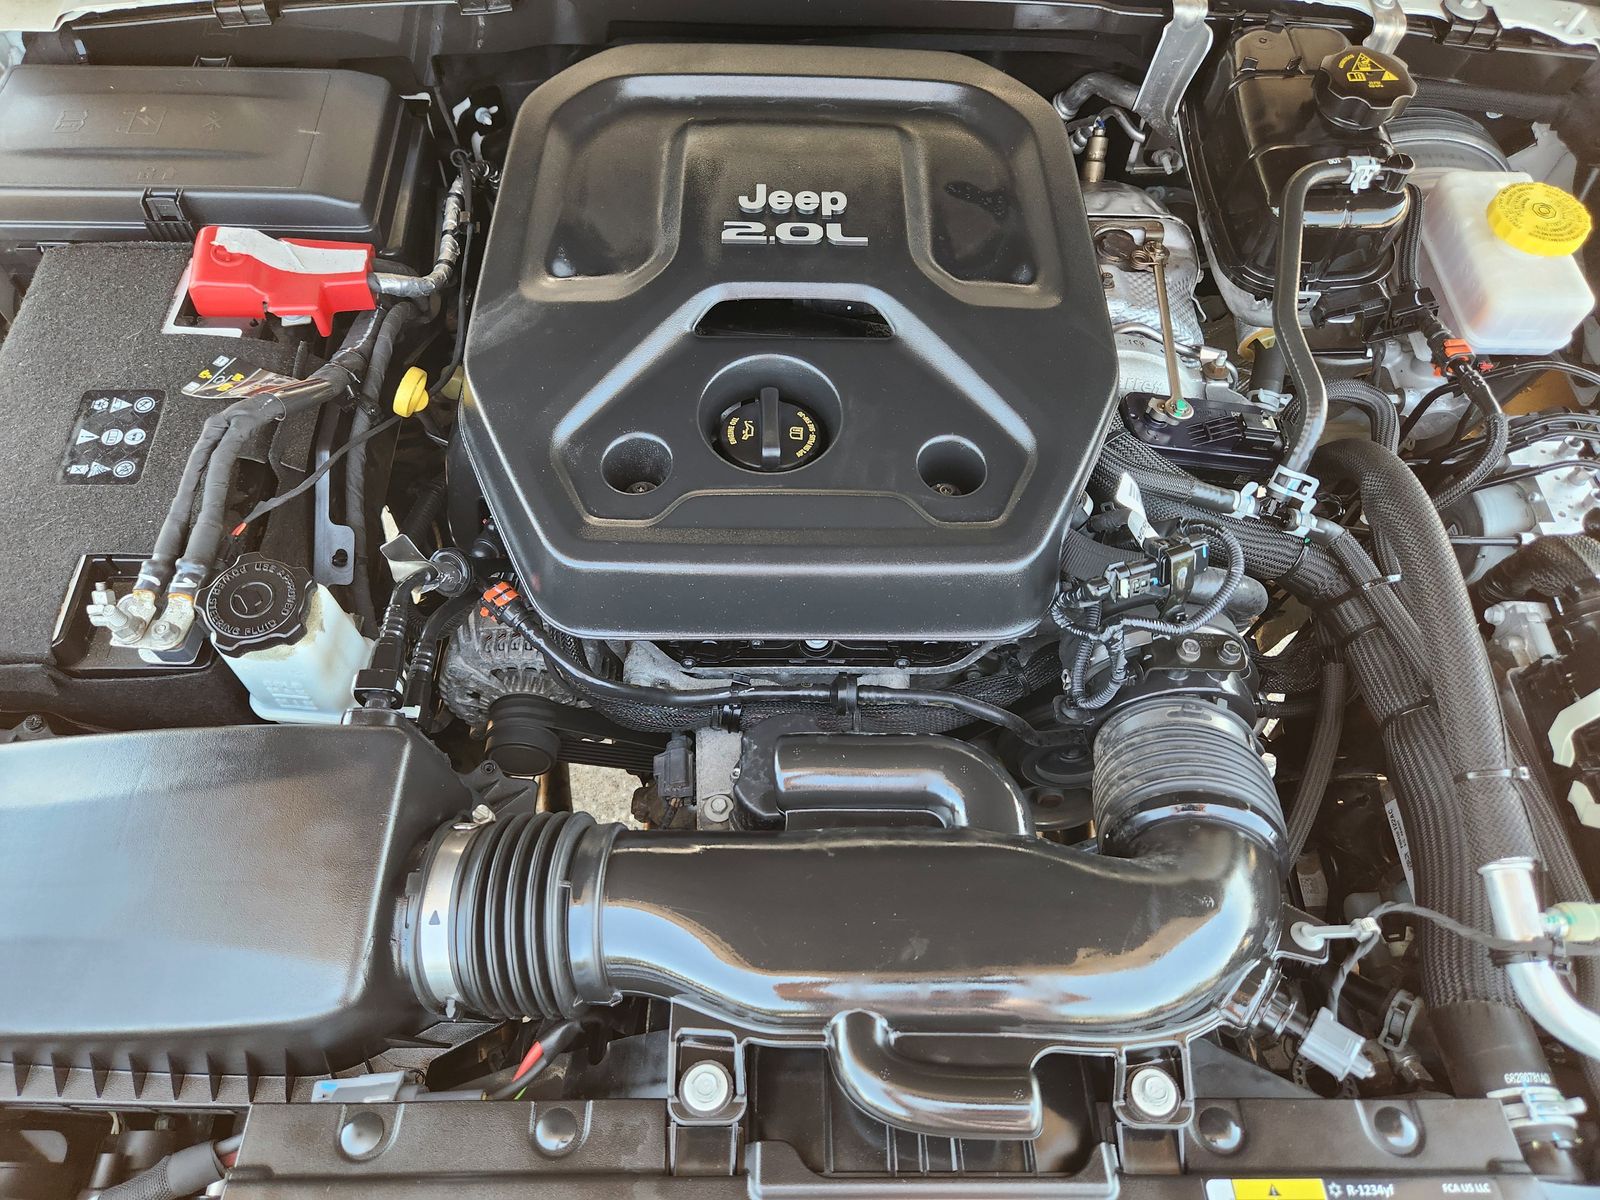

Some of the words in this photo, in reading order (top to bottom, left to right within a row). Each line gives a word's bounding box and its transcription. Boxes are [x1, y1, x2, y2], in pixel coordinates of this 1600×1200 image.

[738, 183, 848, 220] Jeep
[721, 221, 869, 247] 2.0L
[729, 417, 740, 425] OIL
[727, 425, 737, 445] ENGINE
[212, 565, 247, 595] POWER
[255, 562, 278, 573] USE
[276, 570, 296, 616] APPROVED
[208, 597, 241, 636] STEERING
[244, 619, 277, 635] FLUID
[1345, 1183, 1395, 1198] R-1234yf
[1441, 1182, 1461, 1193] FCA
[1460, 1182, 1475, 1193] US
[1473, 1182, 1491, 1193] LLC
